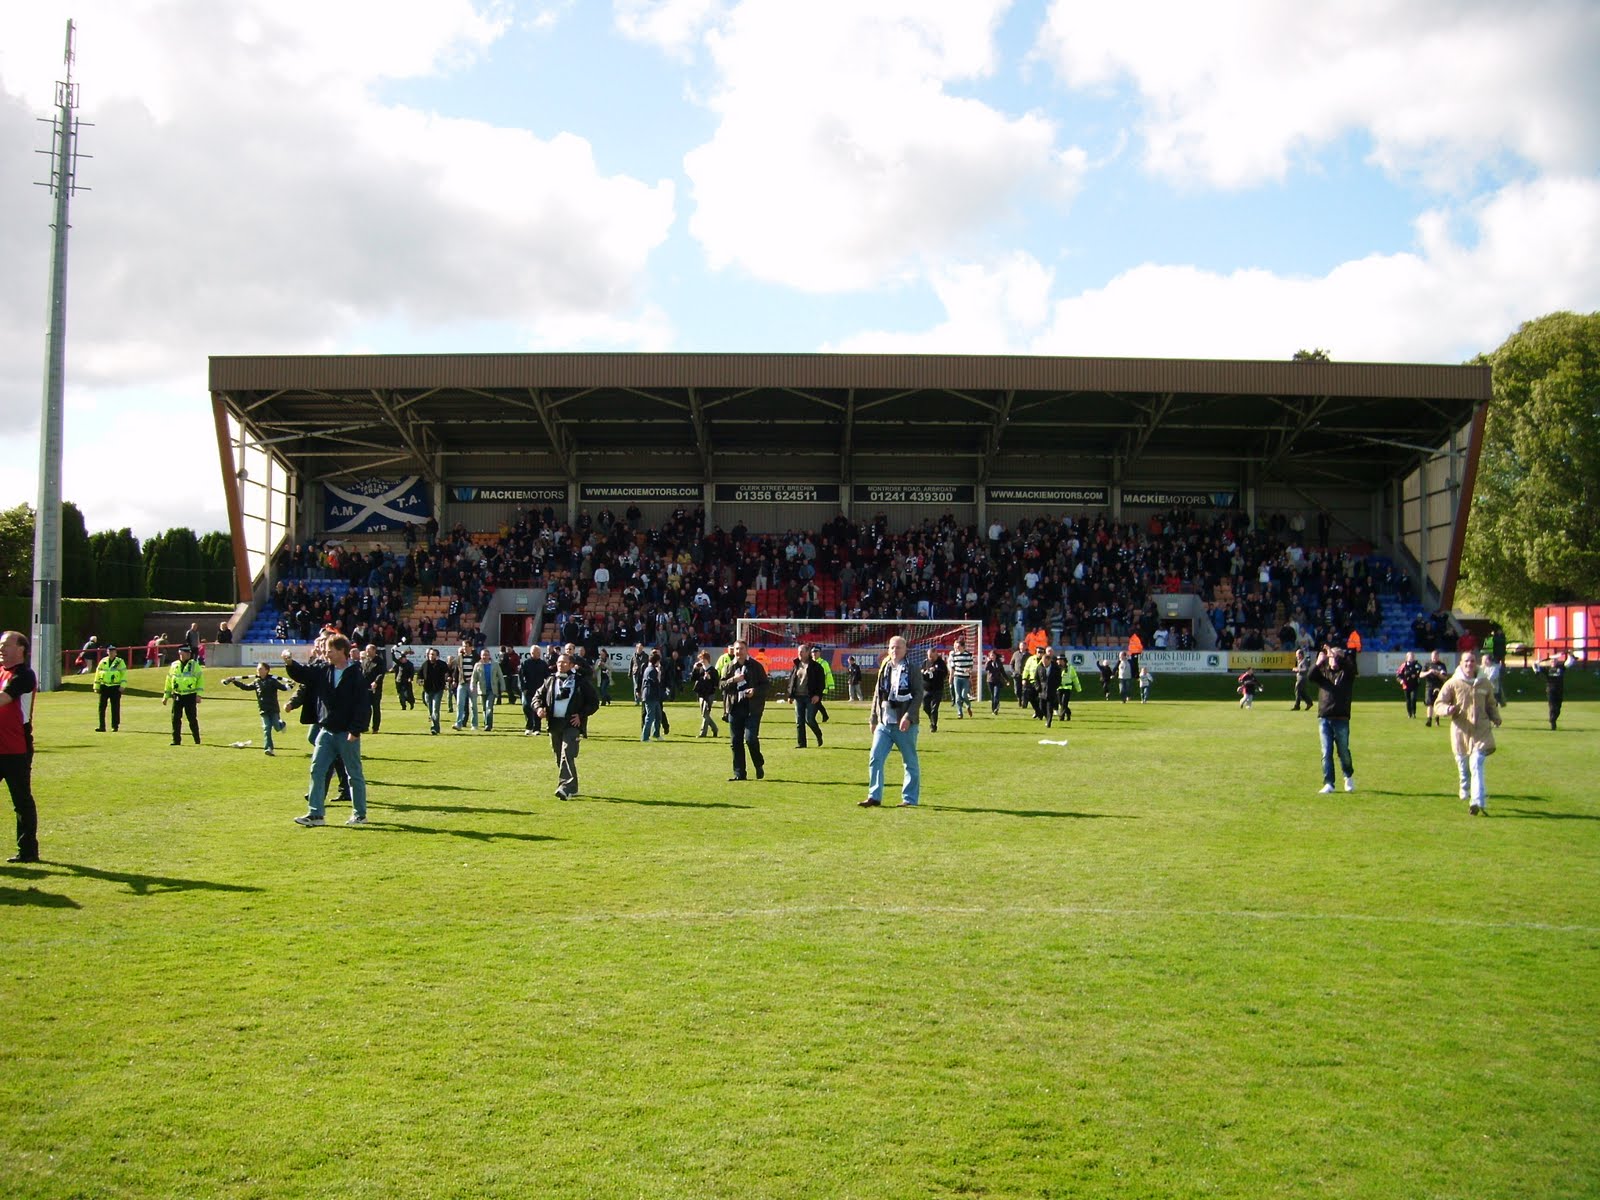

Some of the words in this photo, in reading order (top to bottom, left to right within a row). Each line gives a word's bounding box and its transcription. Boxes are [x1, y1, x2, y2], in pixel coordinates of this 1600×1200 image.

[480, 490, 565, 500] MACKIEMOTORS
[585, 488, 699, 496] WWW.MACKIEMOTORS.COM
[735, 491, 772, 501] 01356
[775, 491, 817, 501] 624511
[870, 491, 906, 501] 01241
[909, 492, 953, 502] 439300
[990, 490, 1103, 500] WWW.MACKIEMOTORS.COM
[1123, 494, 1207, 504] MACKIEMOTORS
[330, 505, 357, 516] A.M.
[366, 524, 388, 533] AYR
[1093, 652, 1121, 660] NETHER
[1138, 652, 1171, 661] RACTORS
[1172, 652, 1201, 661] LIMITED
